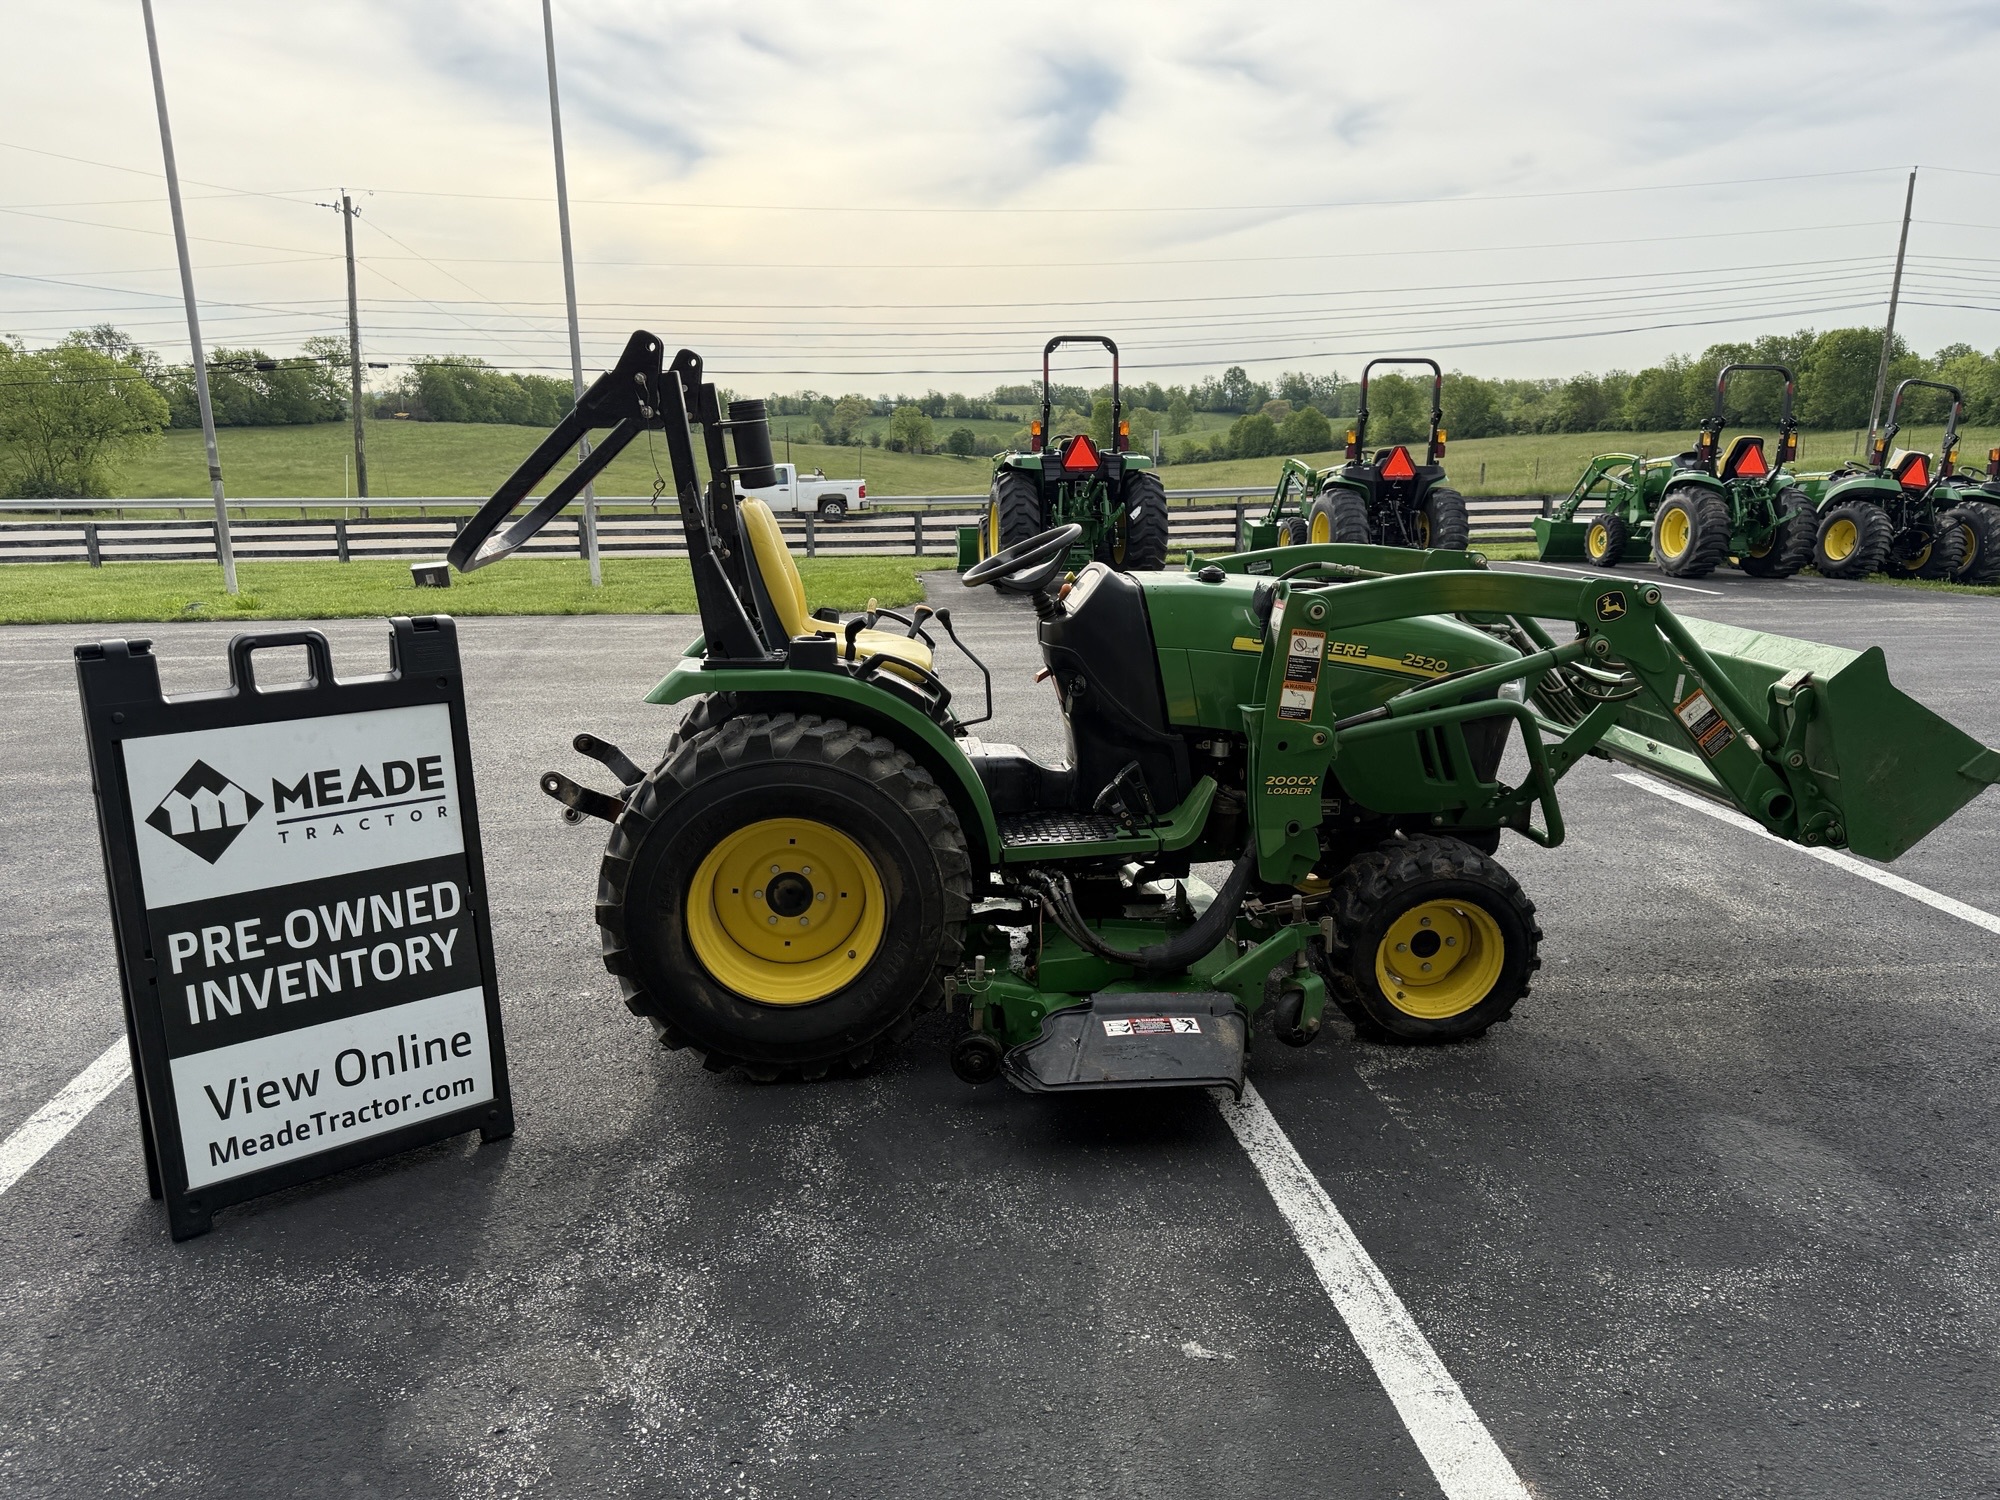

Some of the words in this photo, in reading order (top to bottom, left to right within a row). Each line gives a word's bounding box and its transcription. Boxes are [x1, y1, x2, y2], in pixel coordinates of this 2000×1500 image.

[1298, 630, 1325, 638] WARNING
[1328, 641, 1369, 657] ERE
[1402, 653, 1448, 672] 2520
[1289, 683, 1315, 692] WARNING
[272, 755, 446, 813] MEADE
[1265, 776, 1319, 786] 200CX
[1266, 787, 1313, 795] LOADER
[278, 806, 448, 844] TRACTOR
[168, 881, 461, 975] PRE-OWNED
[185, 928, 460, 1026] INVENTORY
[204, 1064, 321, 1122] View
[335, 1030, 473, 1088] Online
[209, 1074, 476, 1168] MeadeTractor.com
